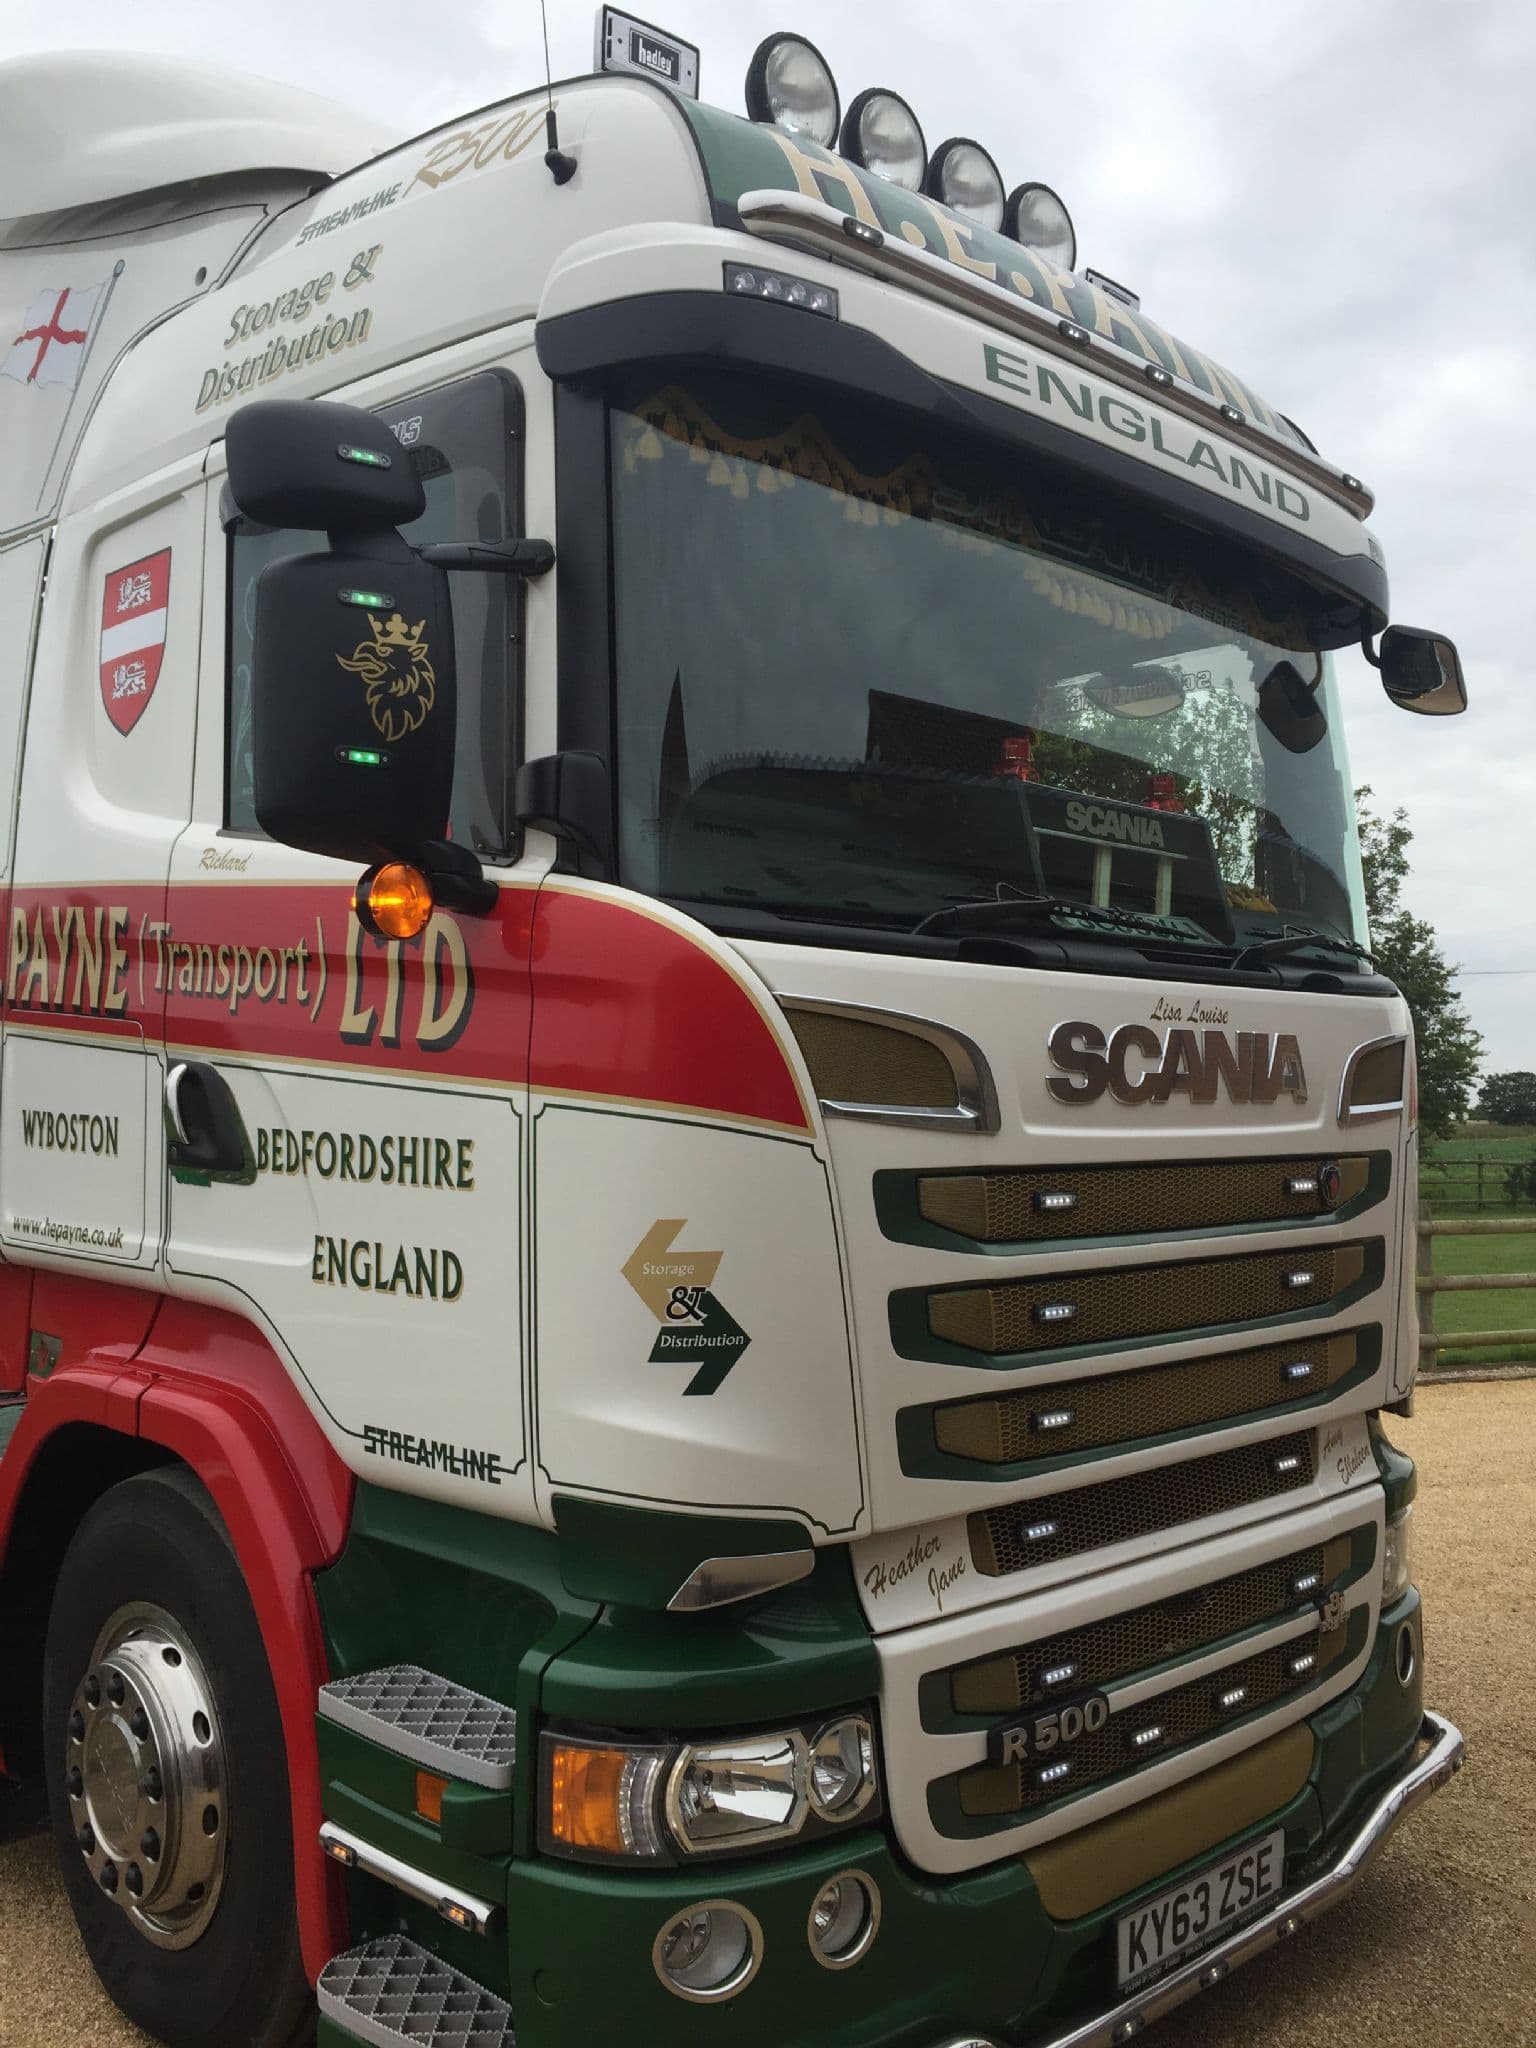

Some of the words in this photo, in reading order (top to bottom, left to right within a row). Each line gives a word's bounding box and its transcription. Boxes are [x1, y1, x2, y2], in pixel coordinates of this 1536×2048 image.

[637, 37, 673, 76] hadley
[295, 180, 403, 248] STREAMLINE
[224, 271, 336, 349] Storage
[342, 243, 385, 293] &
[195, 307, 374, 415] Distribution
[983, 343, 1310, 522] ENGLAND
[1065, 801, 1166, 849] SCANIA
[199, 847, 254, 873] Richard
[6, 904, 130, 1018] PAYNE
[138, 911, 328, 1025] (Transport)
[339, 910, 475, 1053] LTD
[1150, 996, 1183, 1022] Lisa
[1186, 1000, 1229, 1025] Louise
[1045, 1020, 1309, 1106] SCANIA
[22, 1108, 120, 1158] WYBOSTON
[256, 1127, 476, 1192] BEDFORDSHIRE
[12, 1216, 125, 1249] www.hepayne.co.uk
[311, 1234, 465, 1303] ENGLAND
[642, 1261, 696, 1277] Storage
[665, 1284, 708, 1322] &
[660, 1333, 745, 1348] Distribution
[364, 1424, 502, 1485] STREAMLINE
[864, 1534, 942, 1600] Heather
[927, 1556, 966, 1612] Jane
[1002, 1727, 1029, 1766] R
[1034, 1697, 1109, 1752] 500
[1128, 1881, 1211, 1974] KY63
[1218, 1844, 1274, 1921] ZSE
